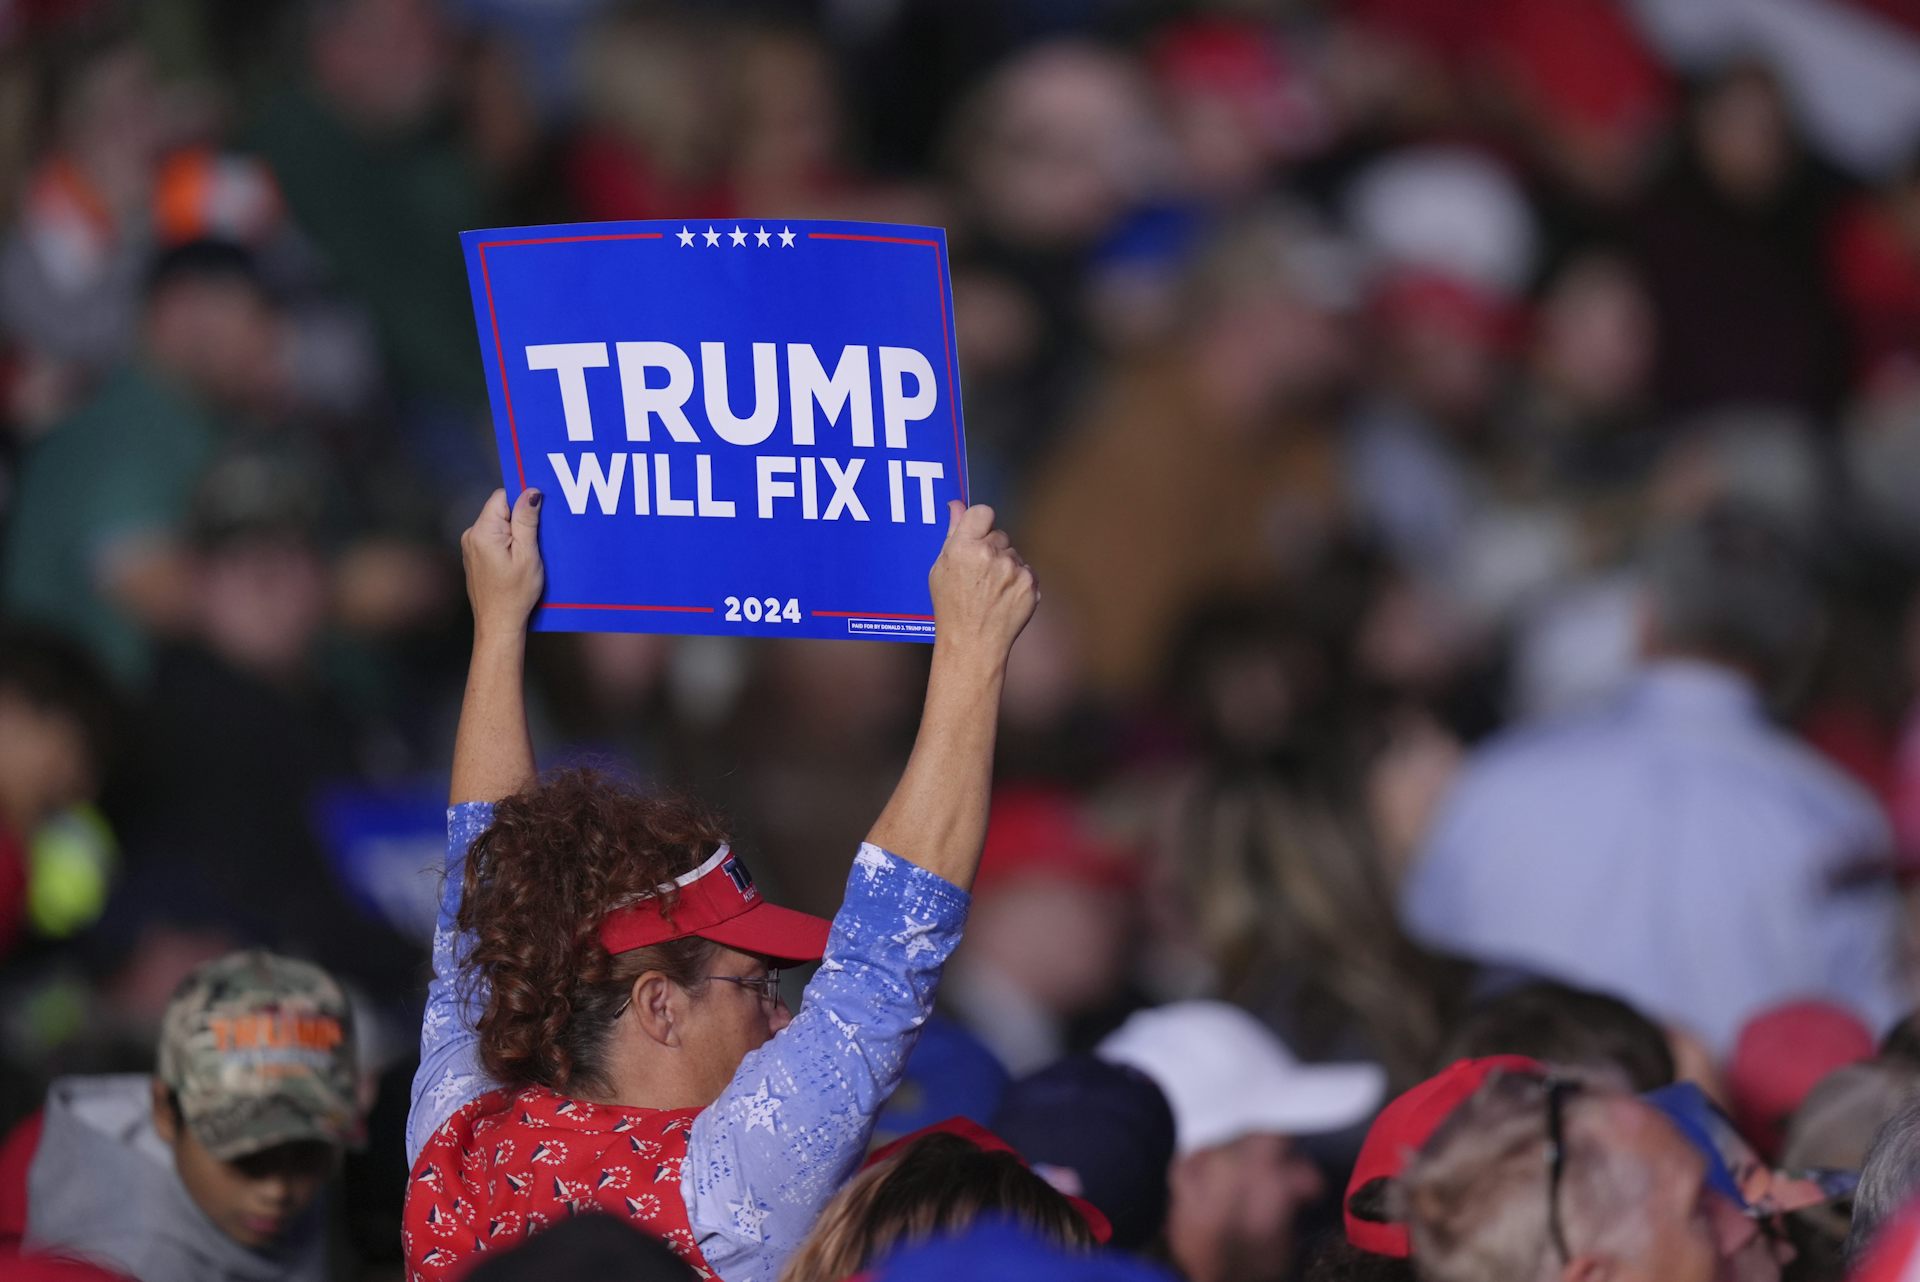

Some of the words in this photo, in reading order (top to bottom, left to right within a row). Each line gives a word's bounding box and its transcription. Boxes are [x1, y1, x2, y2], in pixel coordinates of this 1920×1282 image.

[525, 342, 938, 448] TRUMP
[548, 453, 735, 517] WILL
[756, 456, 870, 522] FIX
[888, 460, 944, 525] IT
[724, 597, 802, 623] 2024
